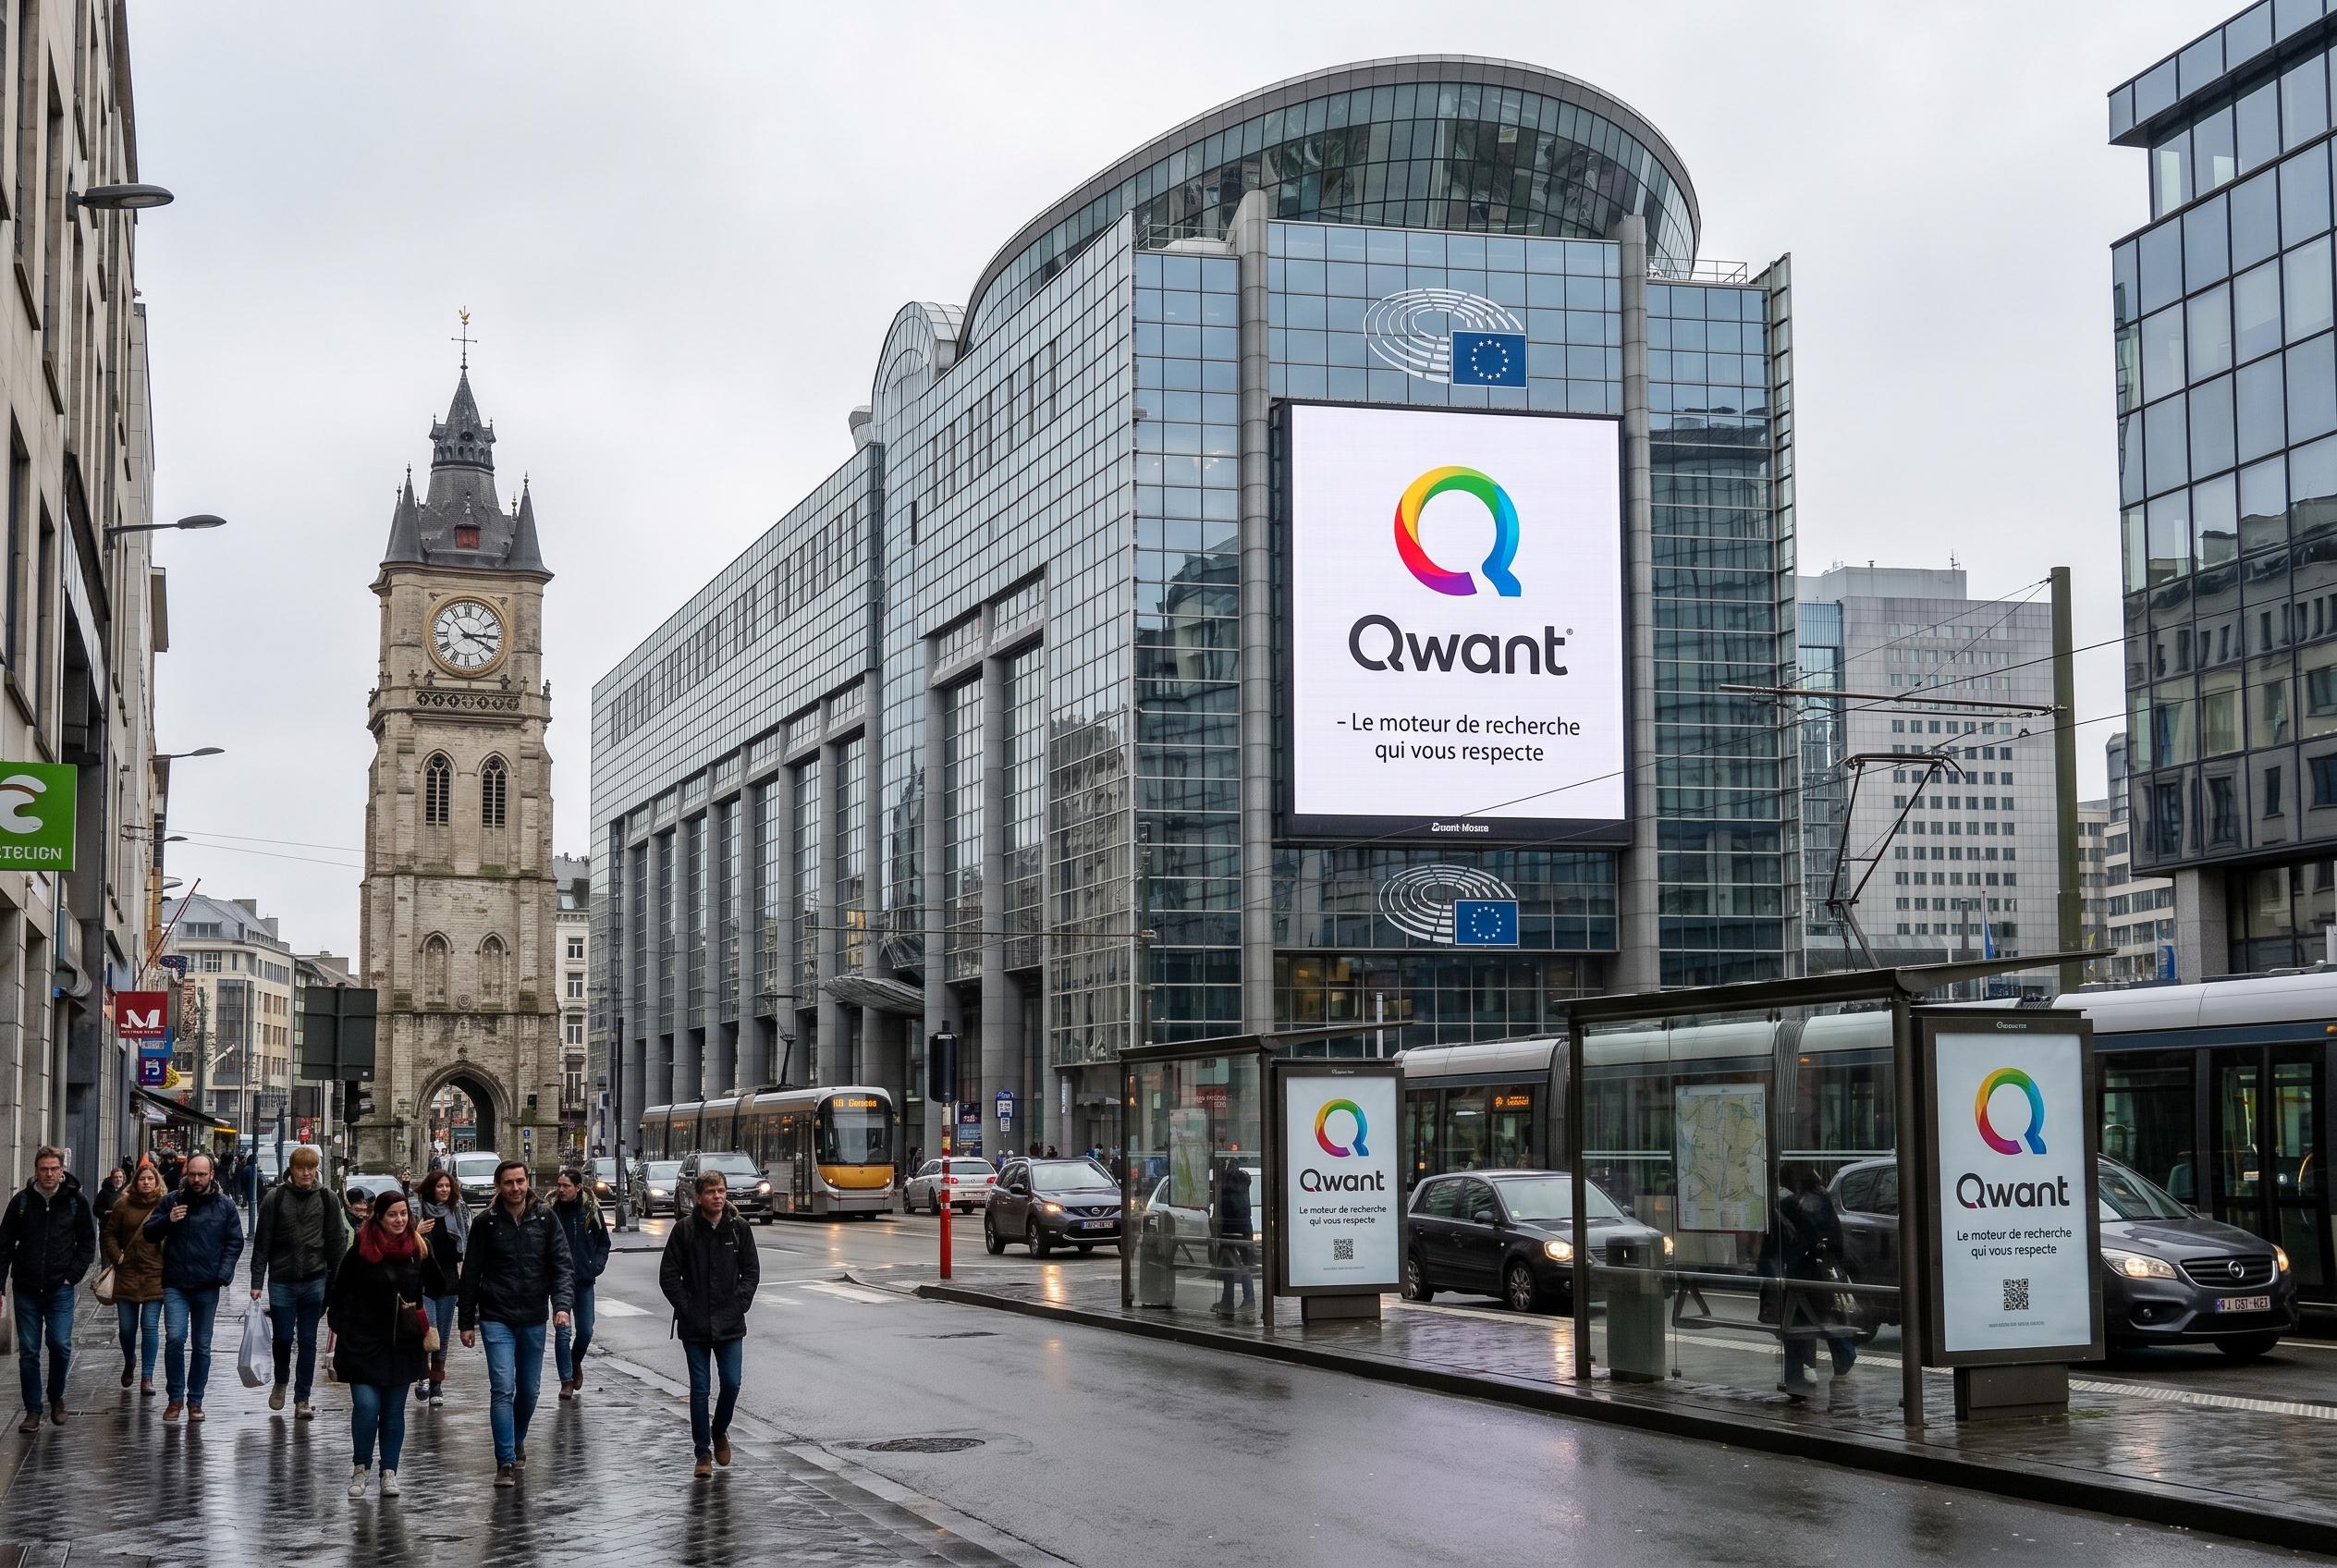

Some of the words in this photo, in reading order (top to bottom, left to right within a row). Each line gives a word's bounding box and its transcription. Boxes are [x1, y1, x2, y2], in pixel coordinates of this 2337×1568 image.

[1352, 713, 1374, 731] Le
[1379, 716, 1450, 733] moteur
[1456, 714, 1480, 733] de
[1486, 716, 1580, 735] recherche
[1375, 741, 1404, 763] qui
[1411, 744, 1456, 760] vous
[1462, 743, 1544, 765] respecte
[1300, 1168, 1385, 1193] Qwant
[1956, 1172, 2070, 1208] Qwant
[1299, 1207, 1308, 1215] Le
[1339, 1206, 1348, 1214] de
[1350, 1205, 1387, 1214] recherche
[1309, 1217, 1322, 1227] qui
[1342, 1216, 1376, 1226] respecte
[1957, 1231, 1969, 1241] Le
[1971, 1230, 2006, 1241] moteur
[2009, 1229, 2022, 1239] de
[2024, 1227, 2072, 1239] recherche
[1971, 1245, 1987, 1260] qui
[1989, 1246, 2013, 1256] vous
[2014, 1243, 2057, 1257] respecte
